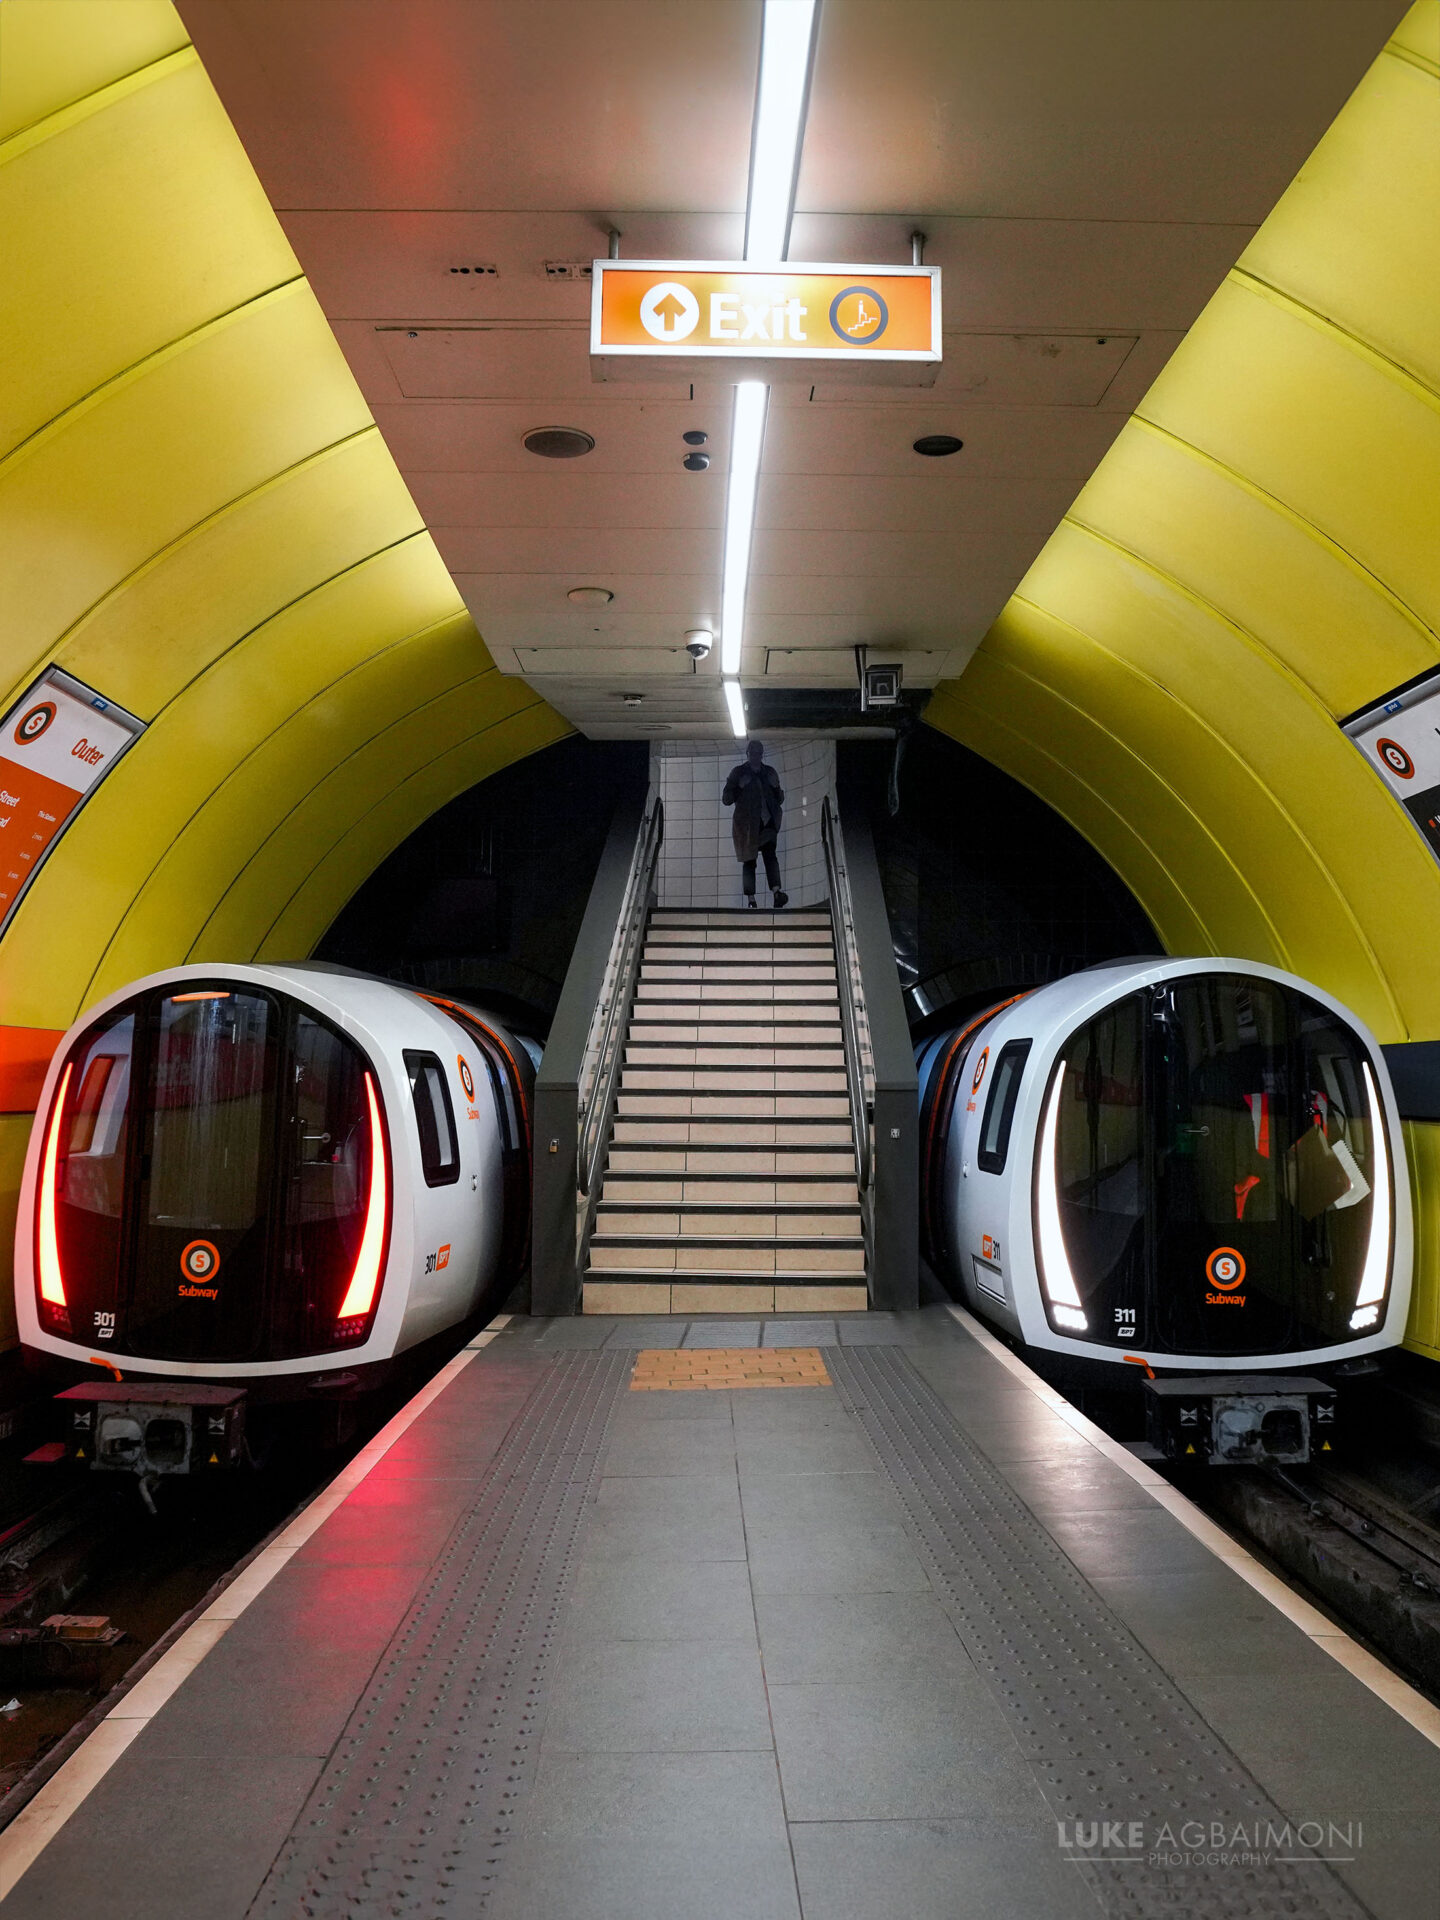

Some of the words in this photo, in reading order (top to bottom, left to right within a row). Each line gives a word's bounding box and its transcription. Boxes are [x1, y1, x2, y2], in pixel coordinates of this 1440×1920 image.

[709, 292, 807, 341] Exit
[71, 738, 105, 766] Outer
[424, 1251, 437, 1275] 301
[178, 1285, 219, 1301] Subway
[1204, 1293, 1247, 1308] Subway
[93, 1311, 116, 1327] 301
[1114, 1308, 1136, 1323] 311
